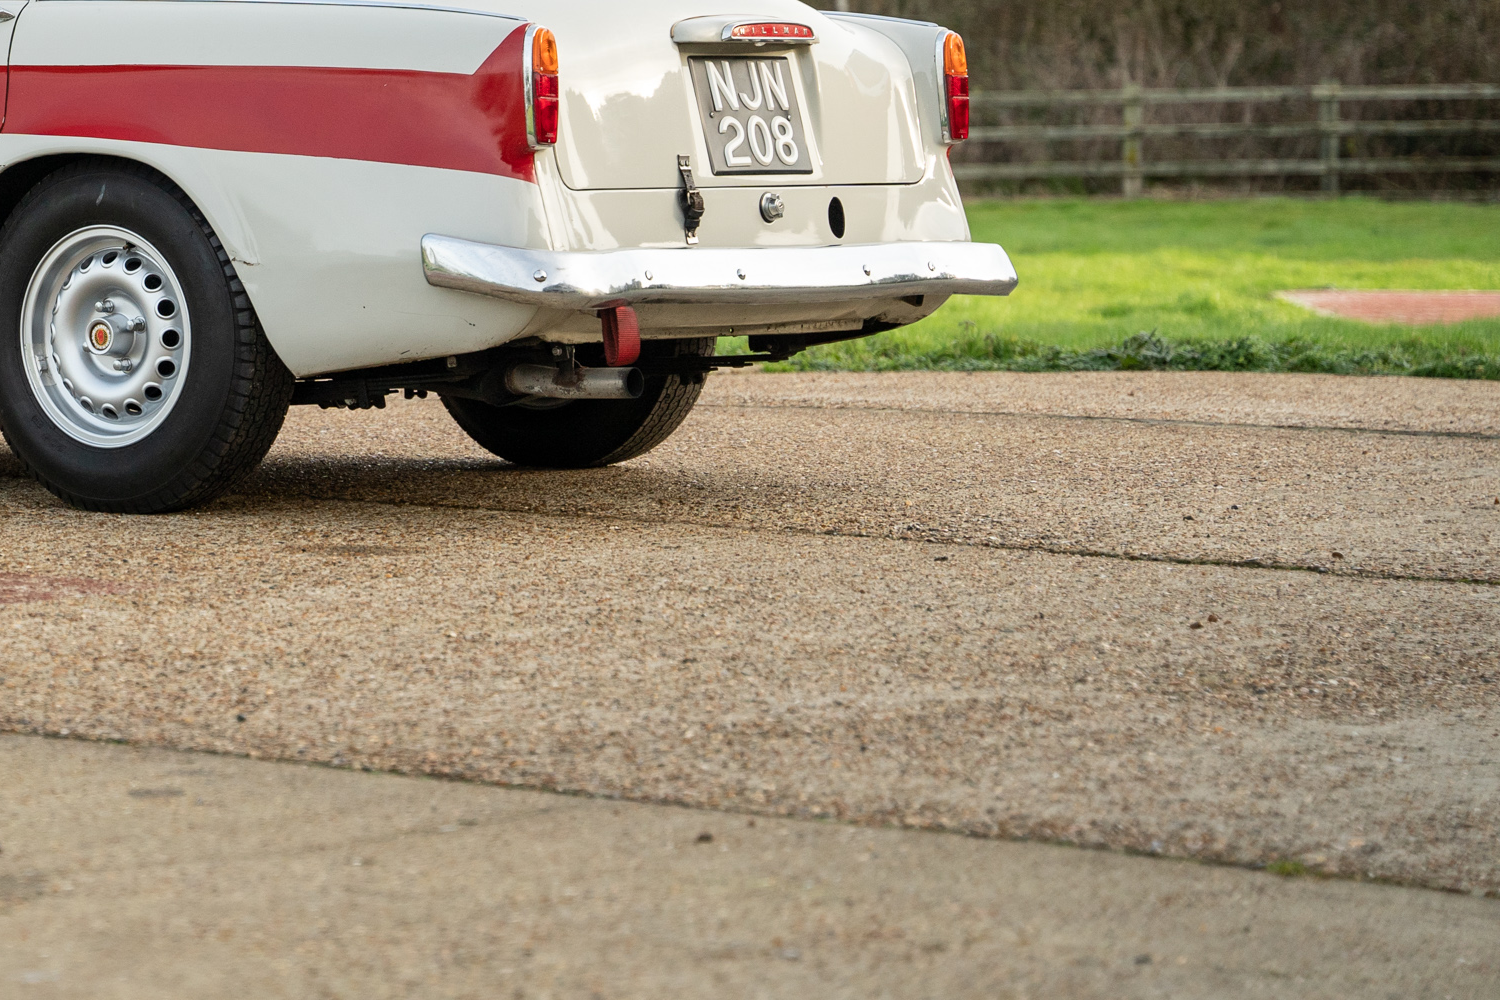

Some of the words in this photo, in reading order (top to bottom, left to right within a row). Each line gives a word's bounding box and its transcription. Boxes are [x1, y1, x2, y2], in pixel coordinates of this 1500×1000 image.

[739, 26, 808, 35] HILLMAN
[705, 61, 789, 111] NJN
[718, 115, 798, 167] 208
